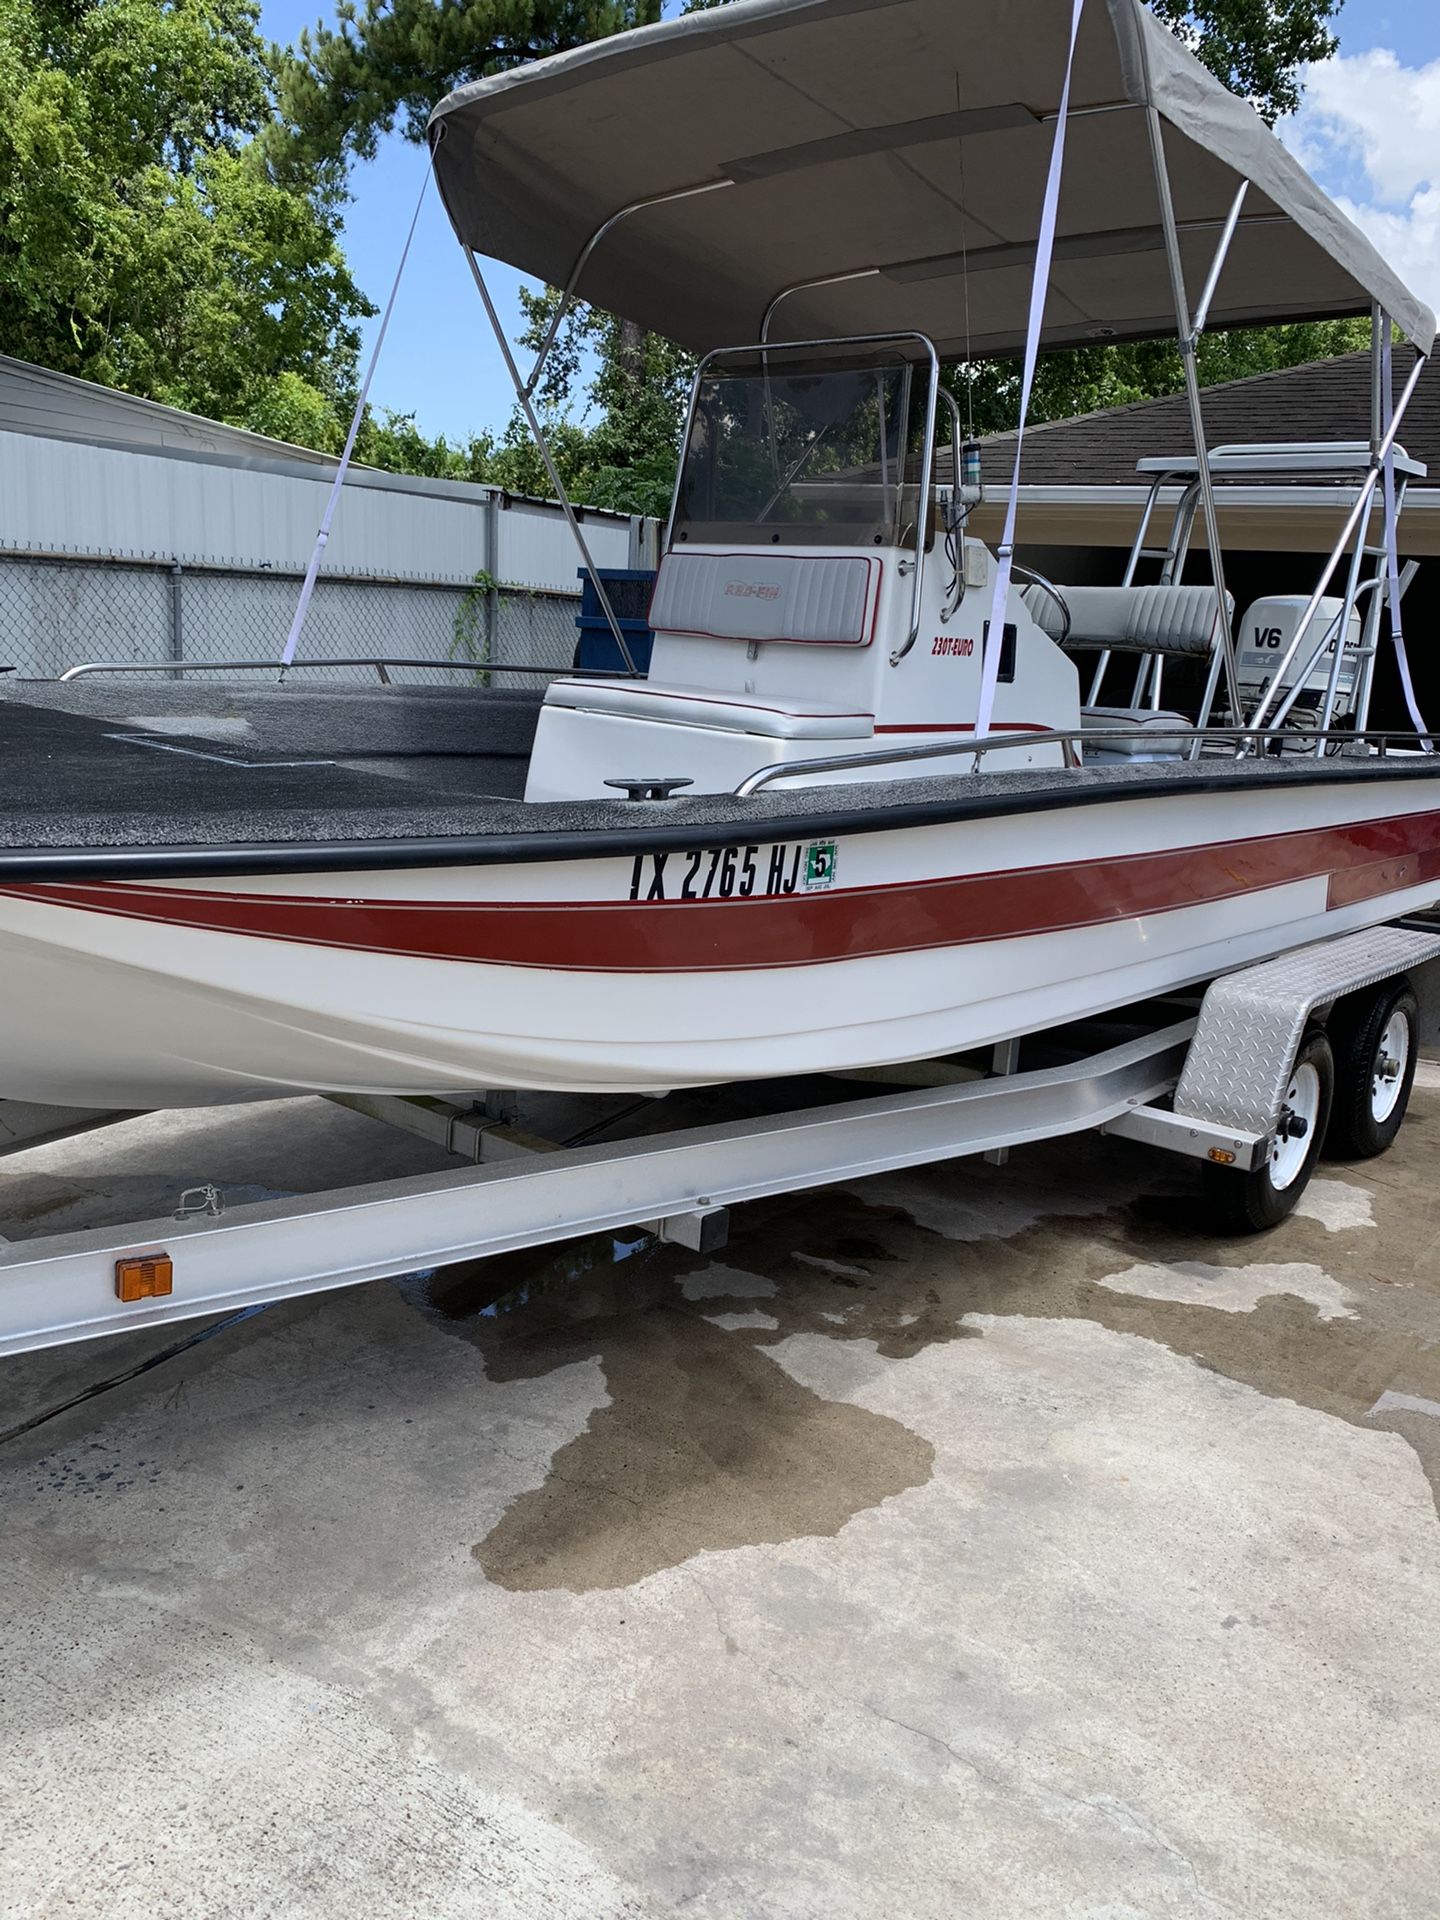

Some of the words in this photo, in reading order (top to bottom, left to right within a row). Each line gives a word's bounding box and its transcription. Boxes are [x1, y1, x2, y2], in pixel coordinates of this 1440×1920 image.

[931, 636, 974, 656] 230T-EURO
[1254, 627, 1282, 649] V6
[681, 846, 758, 899] 2765
[766, 845, 801, 895] HJ
[814, 847, 827, 877] 5
